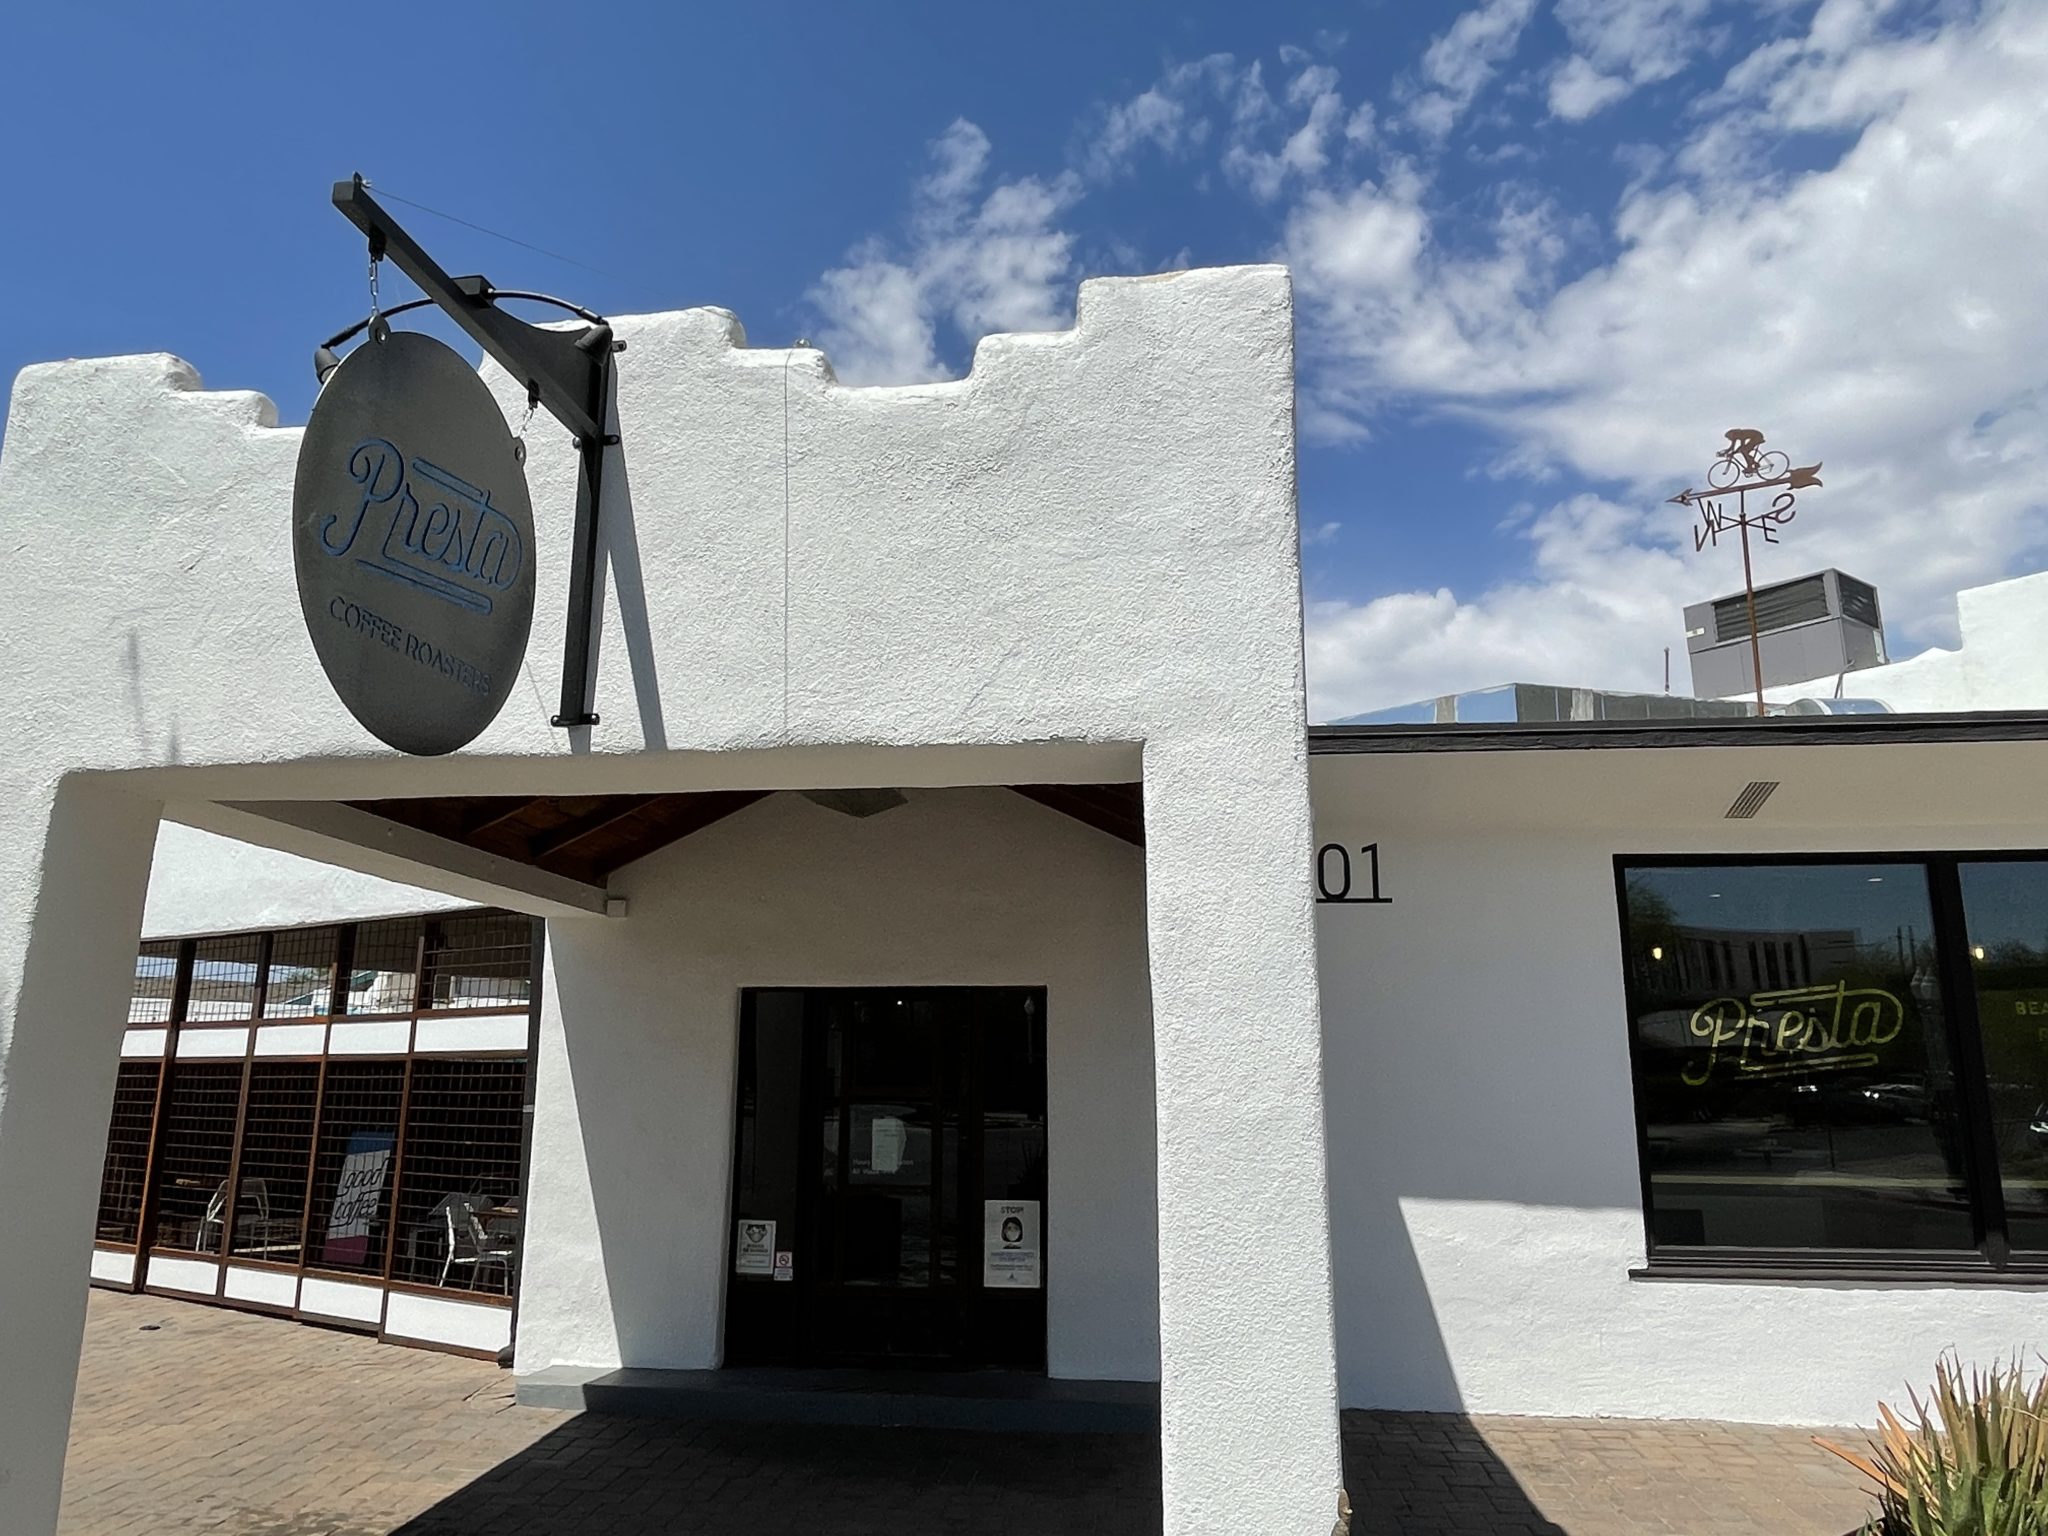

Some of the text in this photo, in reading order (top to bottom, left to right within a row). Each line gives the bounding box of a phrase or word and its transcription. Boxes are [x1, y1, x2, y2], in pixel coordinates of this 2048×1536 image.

[320, 438, 522, 594] Presta
[330, 596, 492, 697] COFFEE ROASTERS
[1316, 843, 1392, 903] 01
[1681, 980, 1903, 1086] Presta
[329, 1188, 383, 1228] coffee
[336, 1157, 390, 1198] good
